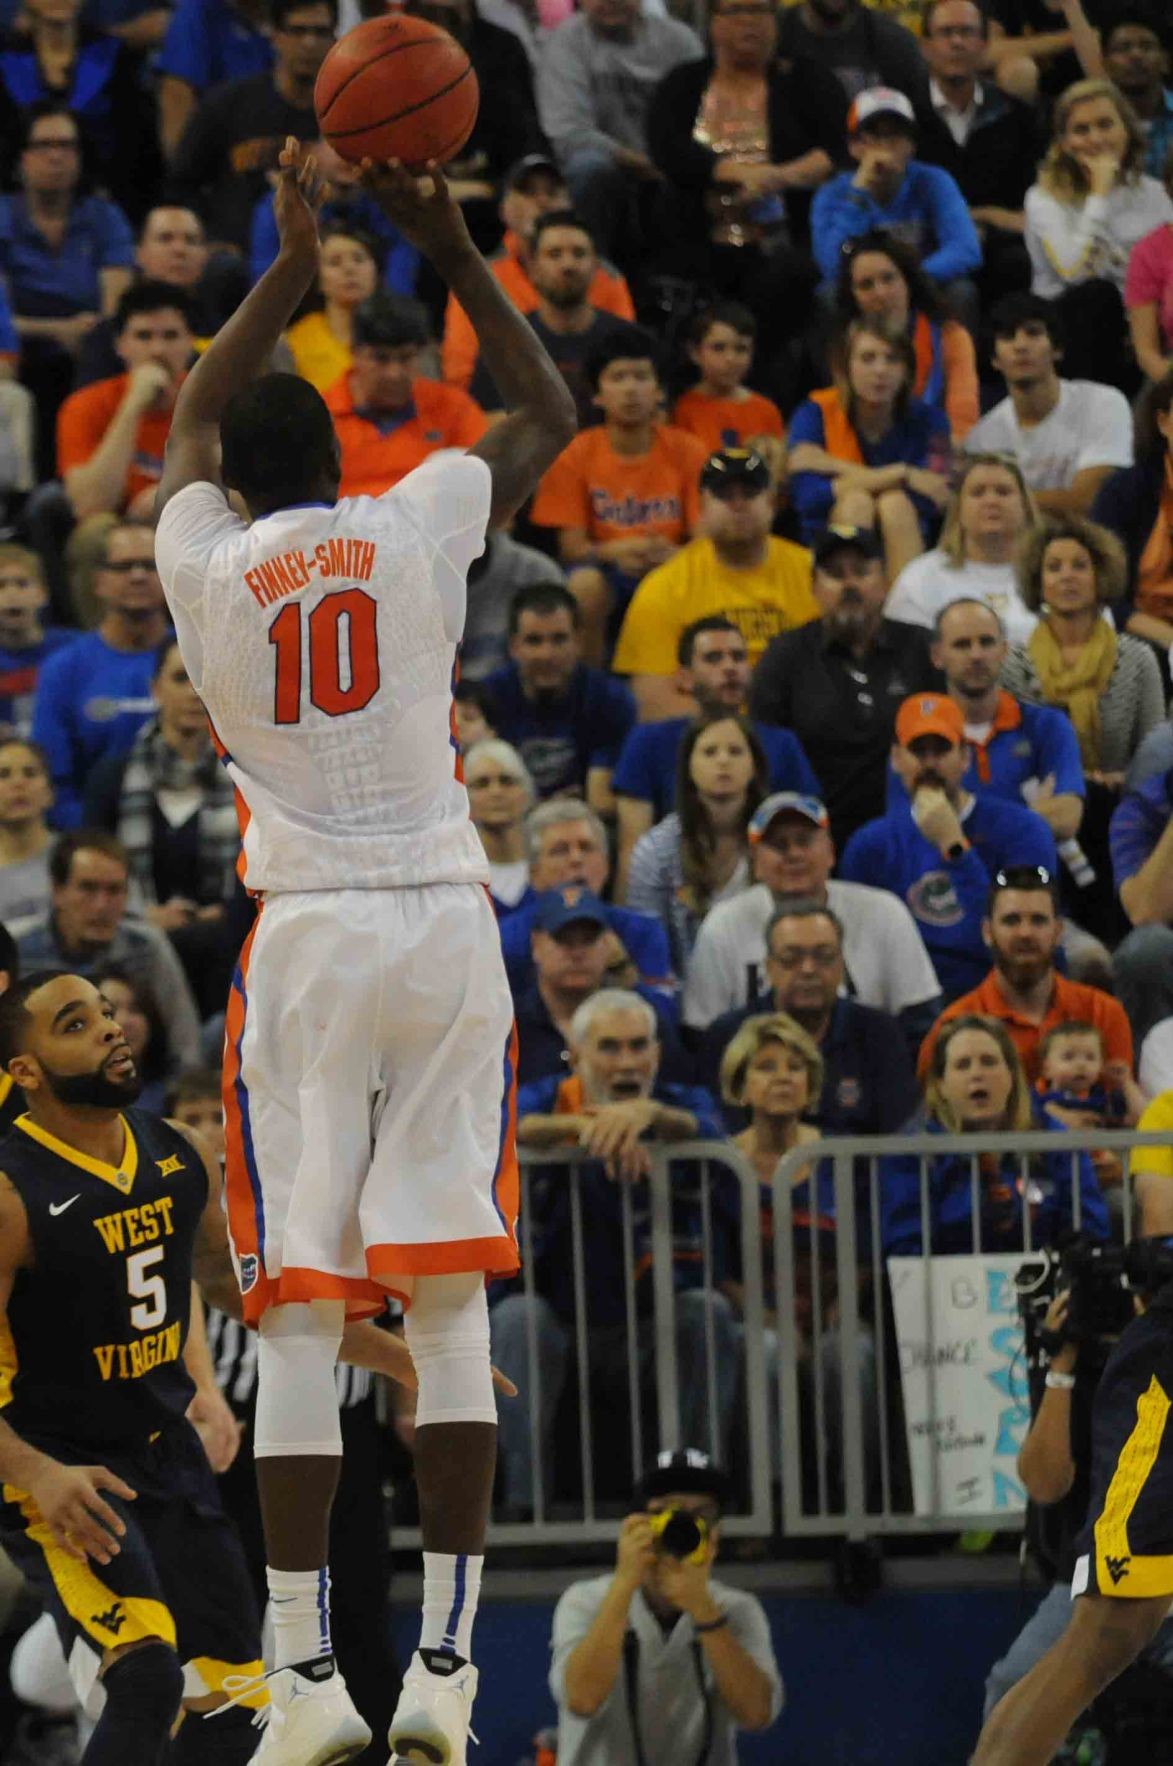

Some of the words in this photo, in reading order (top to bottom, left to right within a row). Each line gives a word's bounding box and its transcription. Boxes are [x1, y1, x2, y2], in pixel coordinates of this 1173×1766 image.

[243, 537, 376, 609] FINNEY-SMITH
[268, 587, 380, 725] 10
[93, 1196, 175, 1255] WEST
[126, 1244, 167, 1331] 5
